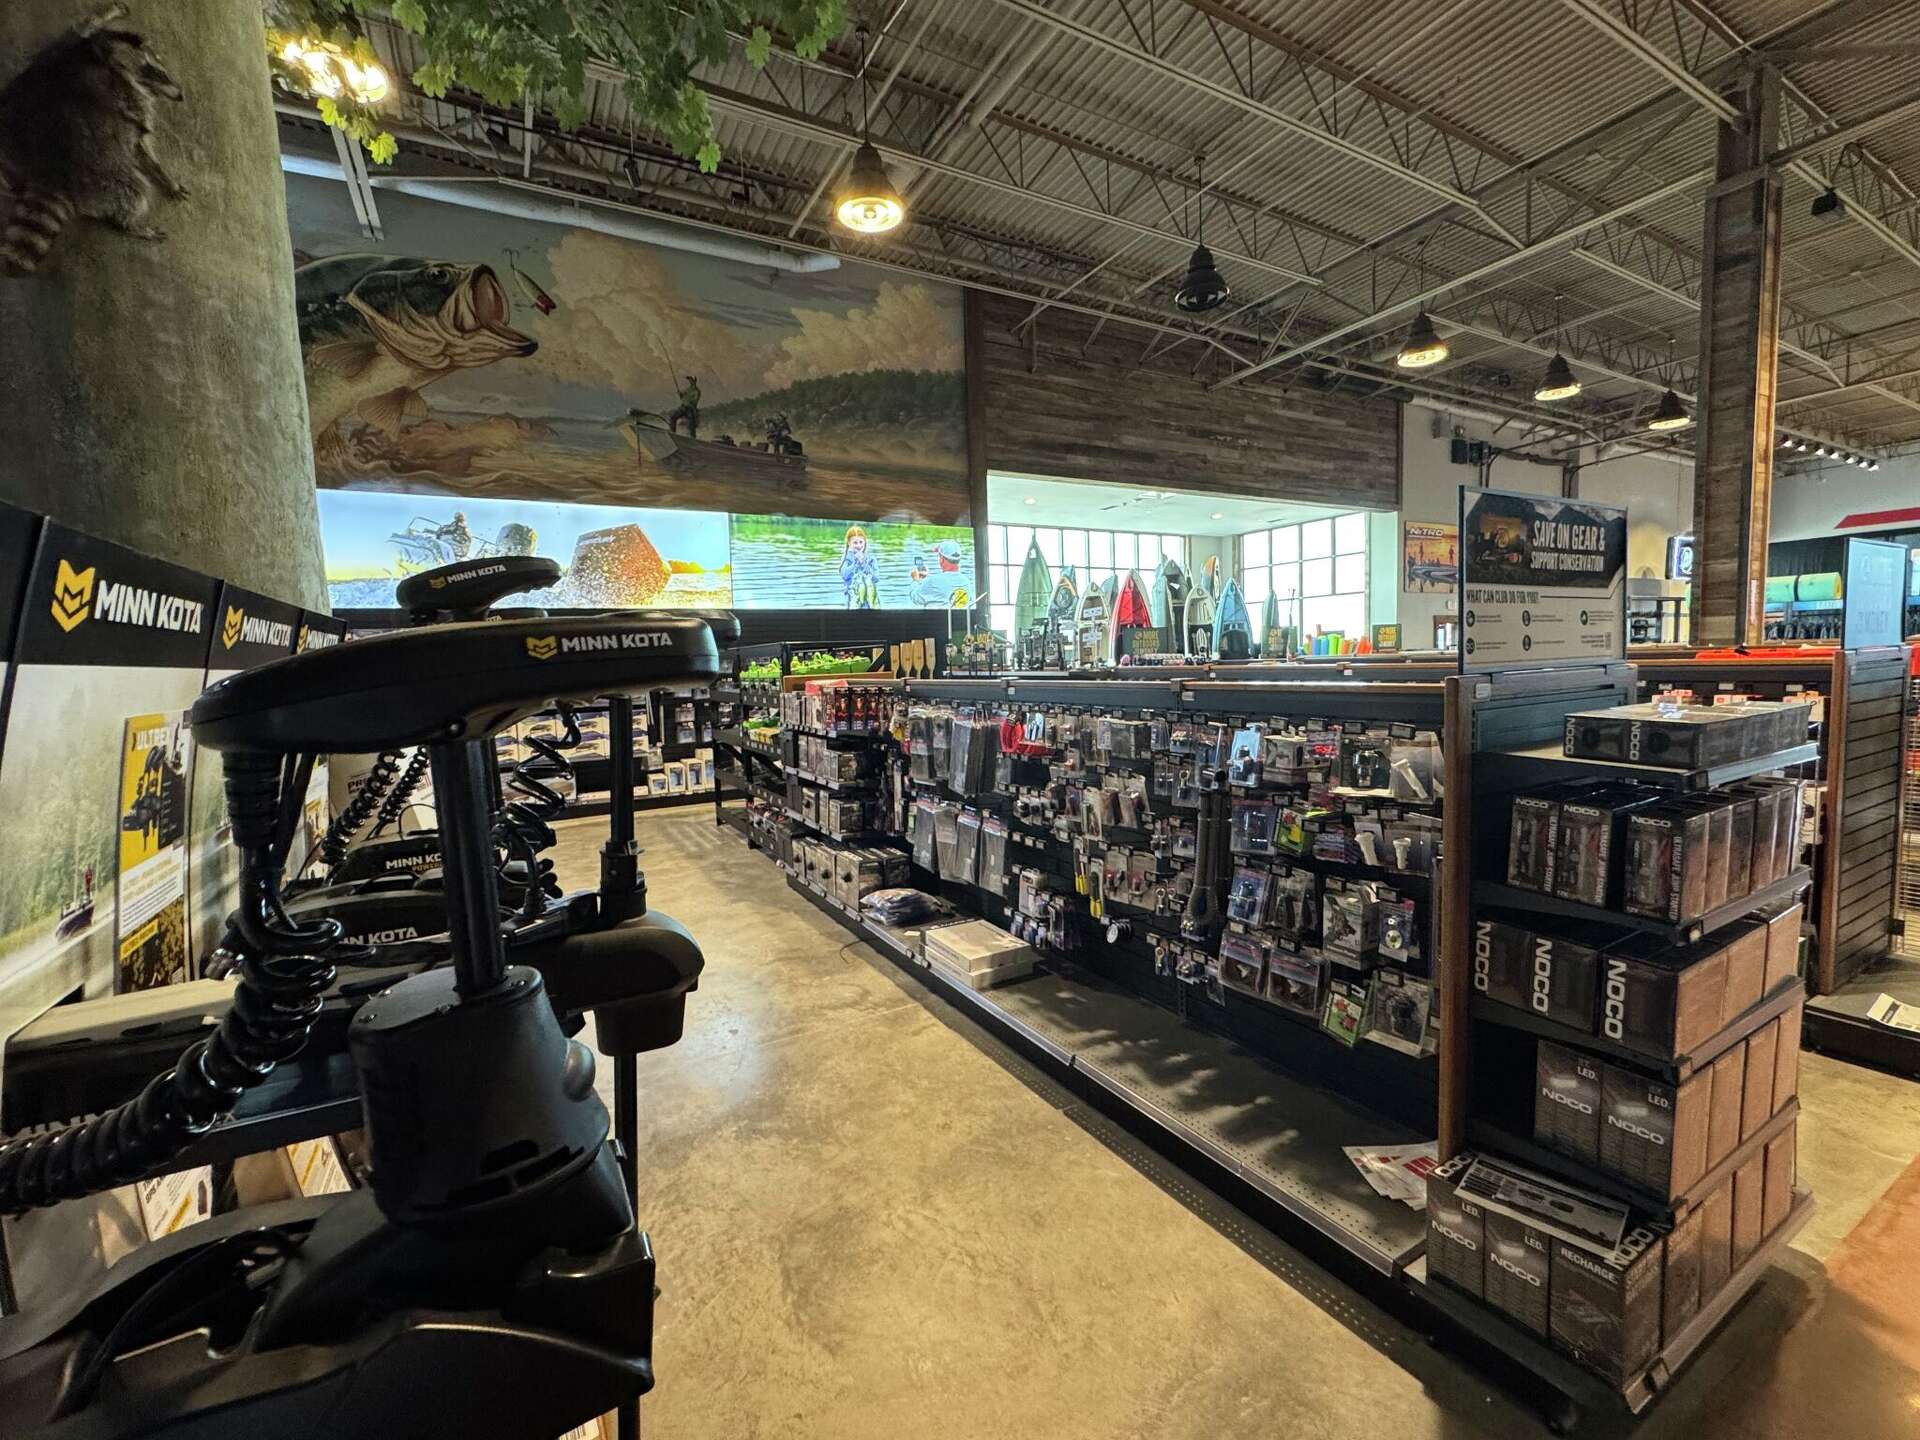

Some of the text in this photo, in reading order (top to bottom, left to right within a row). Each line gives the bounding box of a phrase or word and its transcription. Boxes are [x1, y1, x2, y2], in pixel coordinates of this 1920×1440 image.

[1533, 520, 1606, 551] SAVE ON GEAR &
[446, 564, 506, 583] MINN KOTA
[1530, 551, 1604, 572] SUPPORT CONSERVATION
[94, 580, 203, 633] MINN KOTA
[1466, 589, 1481, 603] WHAT
[1483, 590, 1494, 604] CAN
[240, 615, 293, 647] MINN KOTA
[305, 629, 340, 649] MINN KOTA
[561, 632, 673, 652] MINN KOTA
[1565, 717, 1576, 755] NOCO
[1629, 721, 1641, 761] NOCO
[1515, 798, 1549, 809] NOCO
[1563, 804, 1600, 817] NOCO
[1631, 815, 1672, 828] NOCO
[385, 853, 442, 869] MINN KO
[367, 926, 418, 945] KOTA
[1474, 921, 1492, 992] NOCO
[1532, 938, 1553, 1014] NOCO
[1604, 959, 1627, 1040] NOCO
[1577, 1066, 1596, 1080] LED
[1542, 1087, 1593, 1115] NOCO
[1648, 1093, 1669, 1108] LED
[1608, 1114, 1665, 1145] NOCO
[1461, 1200, 1478, 1216] LED
[1431, 1220, 1476, 1251] NOCO
[1524, 1235, 1542, 1250] LED
[1604, 1227, 1654, 1271] NOCO
[1490, 1252, 1540, 1287] NOCO
[1561, 1247, 1618, 1285] RECHARGE
